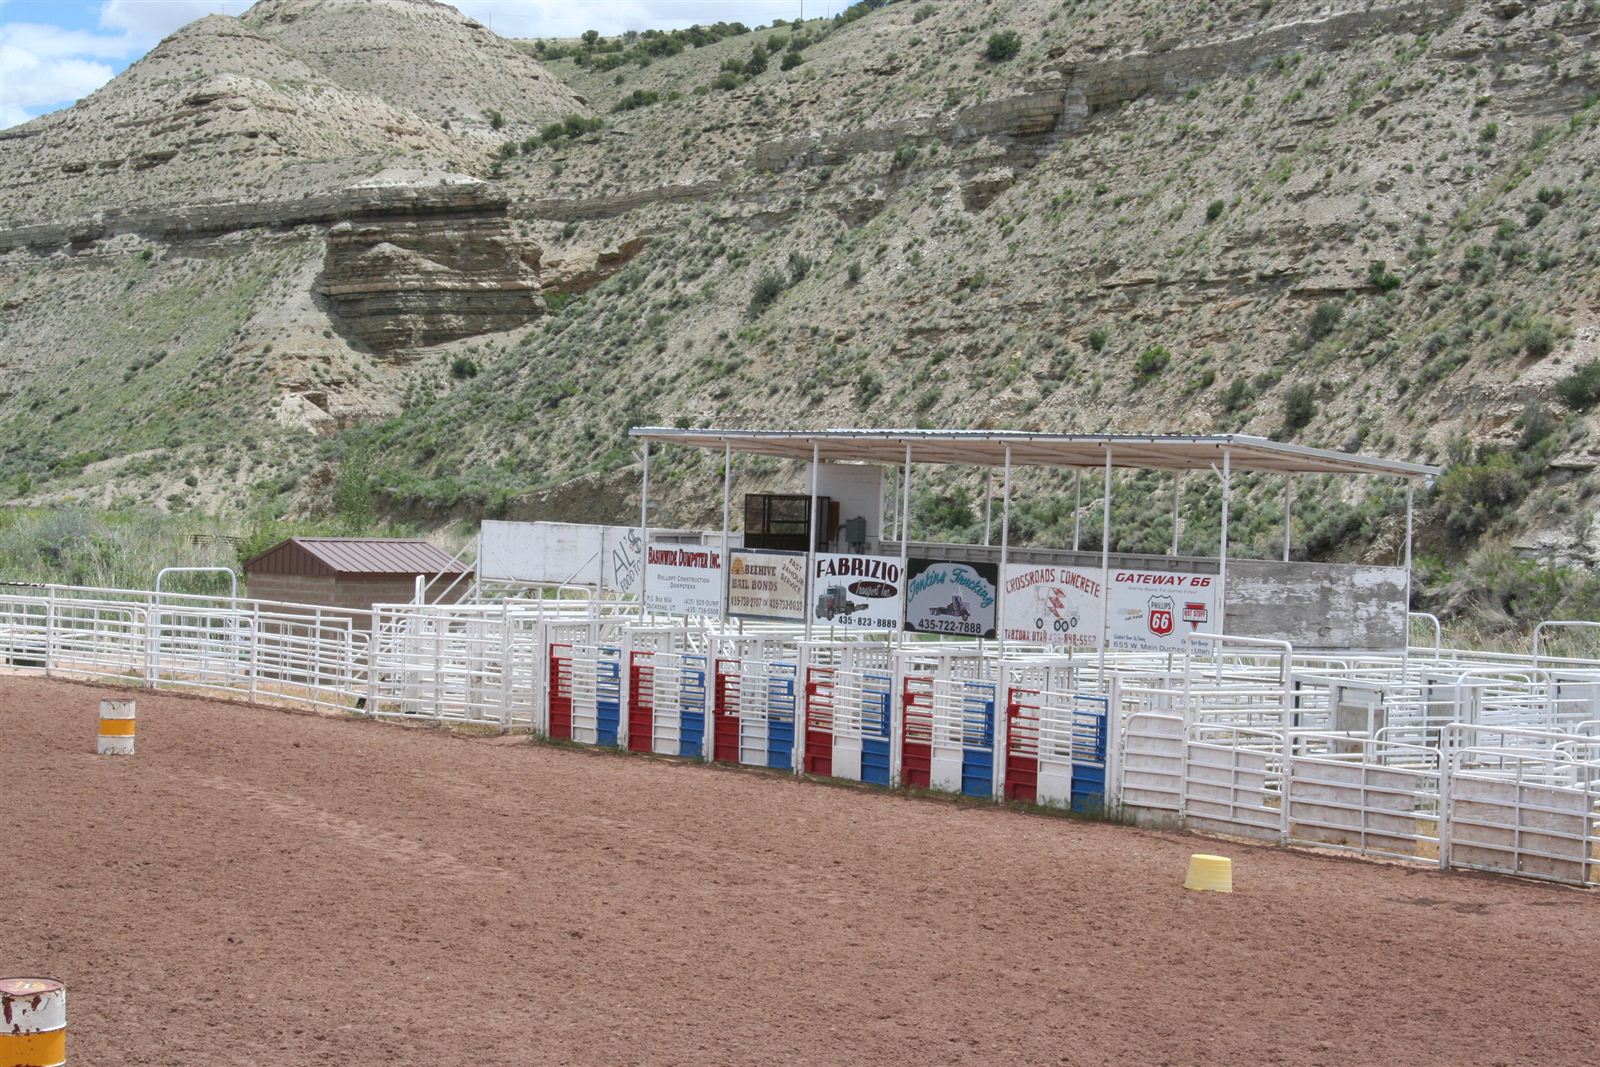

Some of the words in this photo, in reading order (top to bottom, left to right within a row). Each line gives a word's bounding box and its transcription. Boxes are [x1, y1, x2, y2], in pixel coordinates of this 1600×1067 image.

[648, 546, 678, 566] BASINWIDE
[679, 548, 708, 568] DUMPSTER
[745, 564, 776, 577] BEEHIVE
[789, 558, 802, 573] FAST
[731, 578, 749, 590] BAIL
[751, 579, 778, 592] BONDS
[780, 572, 801, 594] SERVICE
[1005, 568, 1056, 594] CROSSROADS
[1060, 569, 1101, 598] CONCRETE
[1115, 572, 1187, 586] GATEWAY
[1190, 576, 1212, 588] 66
[907, 570, 948, 603] Jenkins
[950, 568, 994, 609] Trucking
[1151, 601, 1171, 610] PHILLIPS
[918, 618, 982, 634] 435-722-7888
[1151, 613, 1169, 630] 66
[1113, 640, 1128, 649] 655
[1140, 642, 1158, 650] Main
